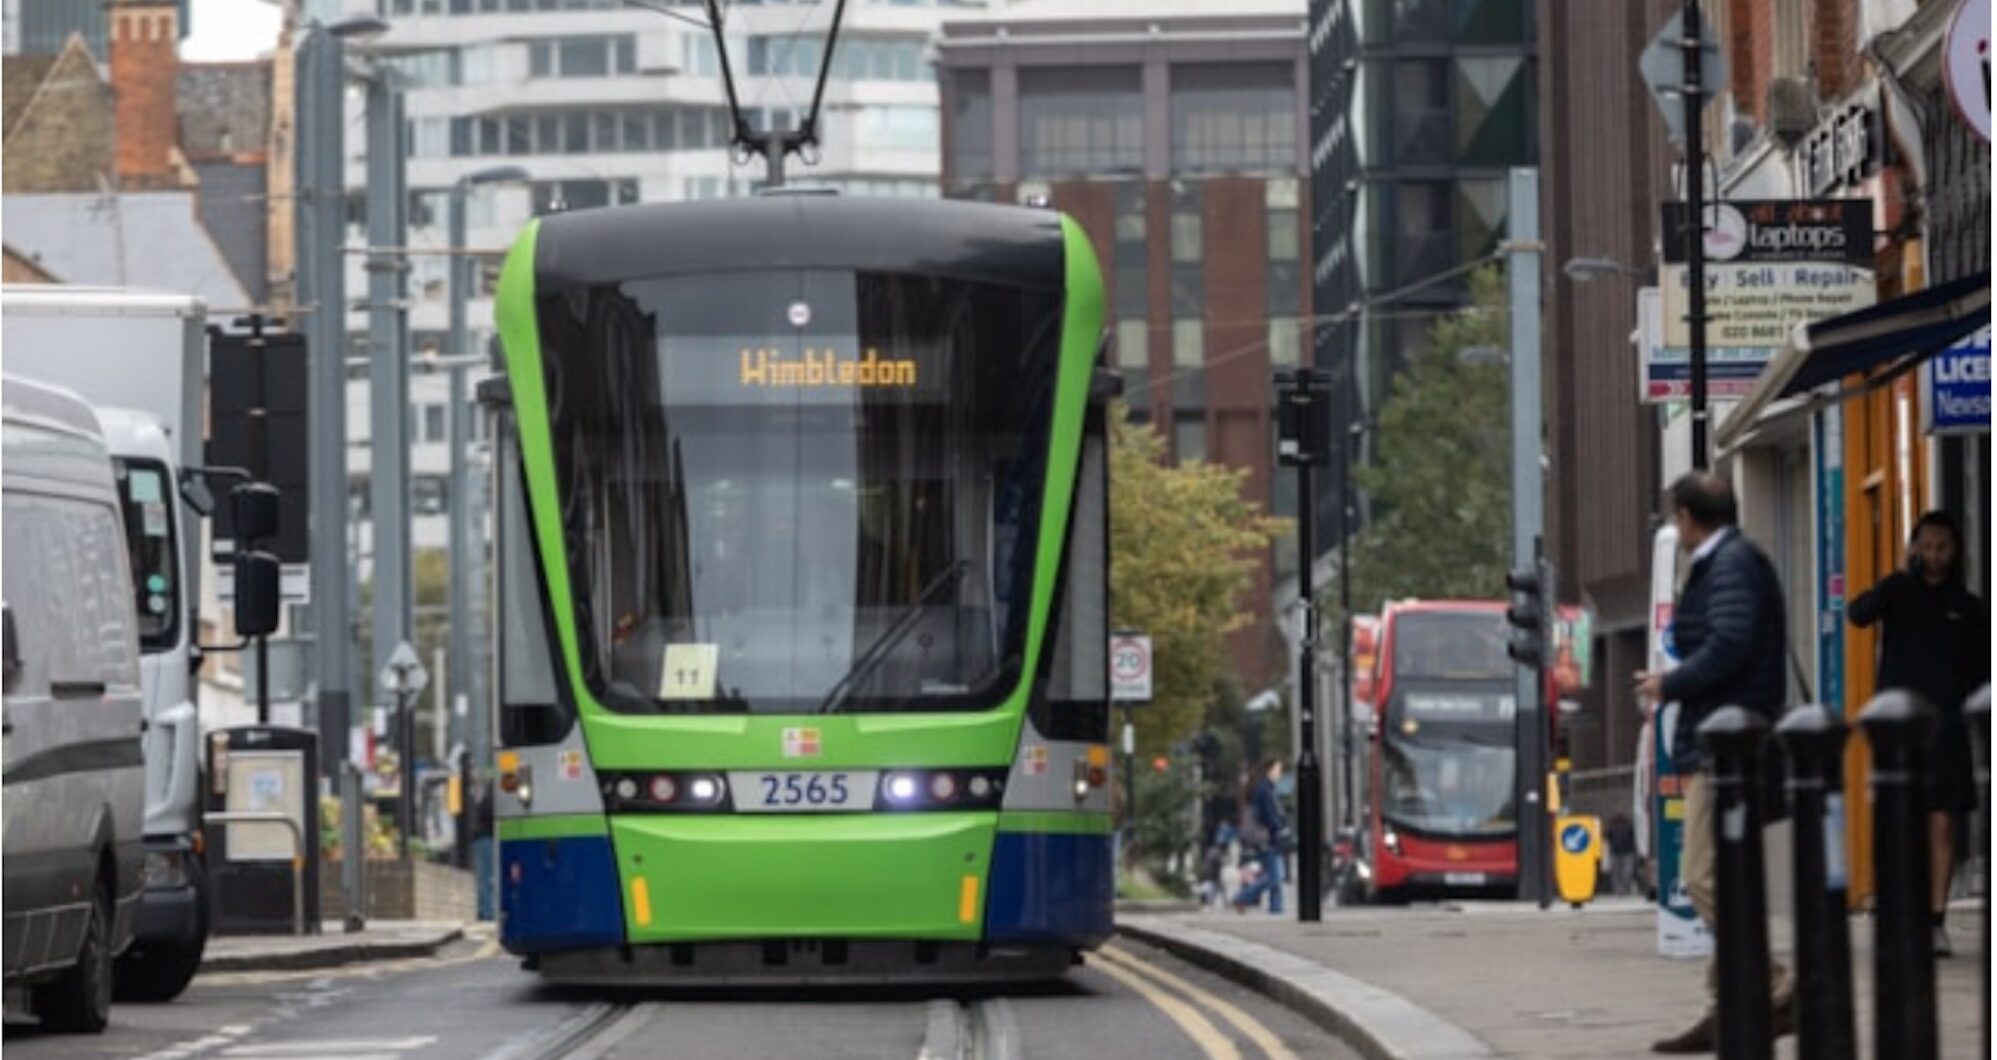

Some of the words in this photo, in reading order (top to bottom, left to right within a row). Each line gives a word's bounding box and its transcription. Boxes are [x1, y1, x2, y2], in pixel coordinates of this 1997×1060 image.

[1752, 223, 1846, 250] laptops
[1680, 270, 1719, 289] By
[1735, 269, 1775, 287] Sell
[1795, 267, 1857, 289] Repair
[740, 347, 916, 384] Wimbledon
[1114, 652, 1140, 670] 20
[675, 668, 699, 686] 11
[760, 774, 848, 806] 2565
